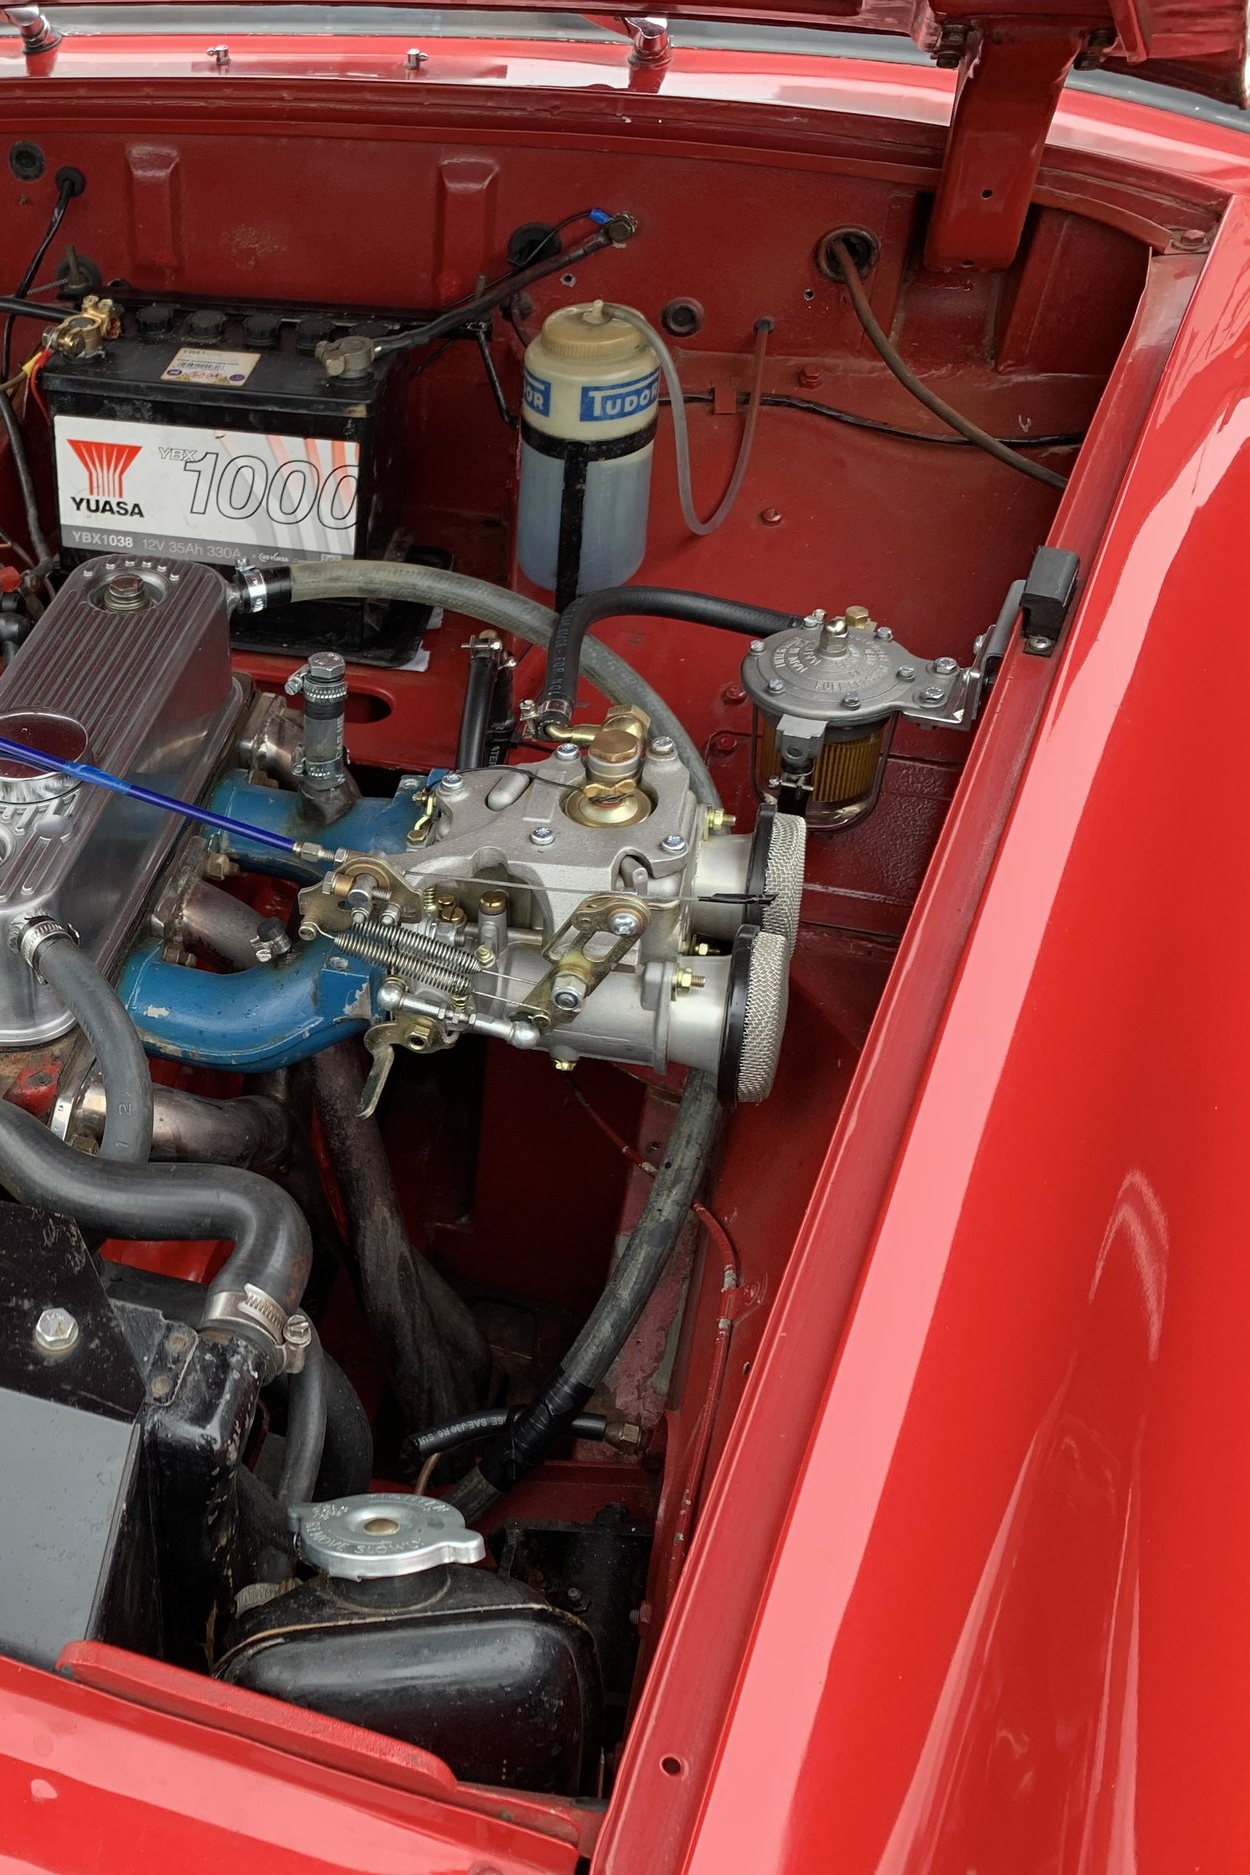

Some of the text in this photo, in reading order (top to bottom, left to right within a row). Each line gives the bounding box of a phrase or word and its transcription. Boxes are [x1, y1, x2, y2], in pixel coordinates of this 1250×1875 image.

[588, 371, 659, 417] TUDOR
[158, 446, 199, 462] YBX
[184, 452, 358, 530] 1000
[70, 496, 145, 519] YUASA
[72, 531, 242, 559] YBX1038 12V 35Ah 330A
